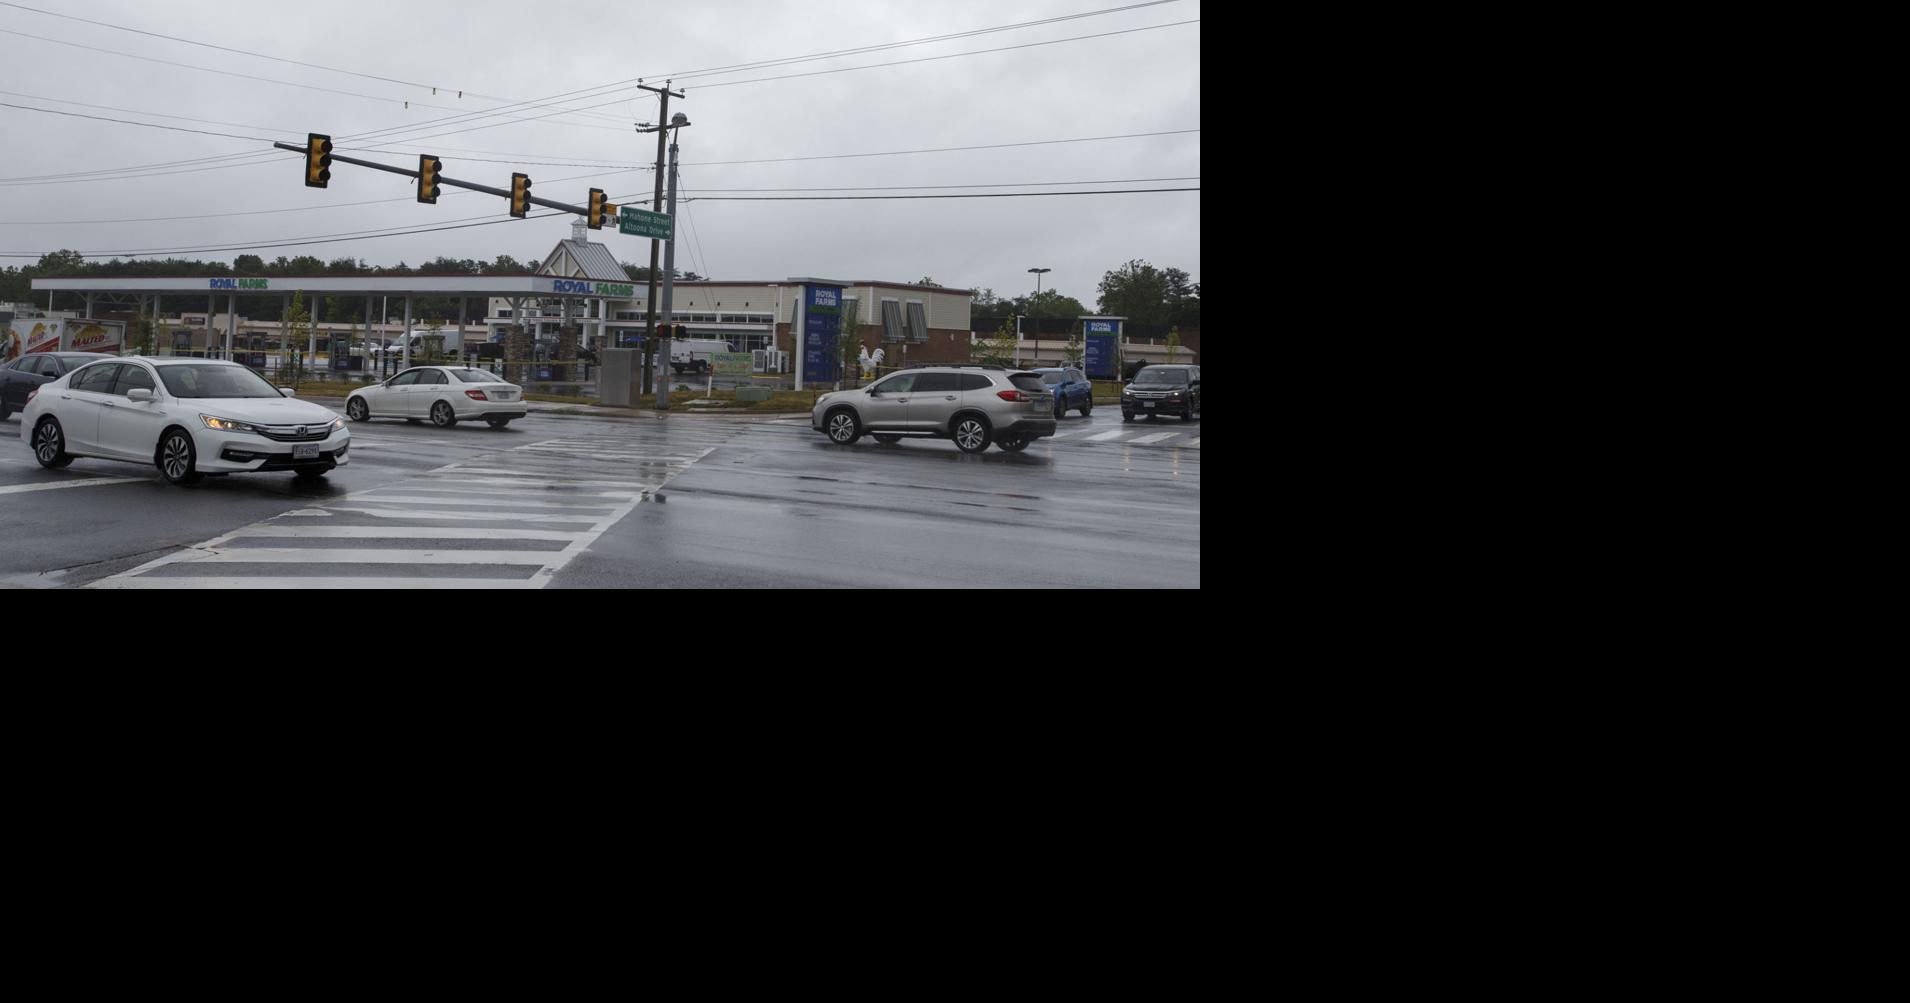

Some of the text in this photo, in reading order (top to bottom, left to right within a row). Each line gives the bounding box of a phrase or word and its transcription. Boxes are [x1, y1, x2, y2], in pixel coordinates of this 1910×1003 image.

[653, 216, 670, 226] Street
[624, 222, 664, 236] Altoona Drive
[209, 278, 268, 289] ROYAL FARMS
[553, 279, 634, 297] ROYAL FARMS
[815, 289, 836, 298] ROYAL
[815, 298, 836, 306] FARMS
[71, 335, 105, 347] MALTED
